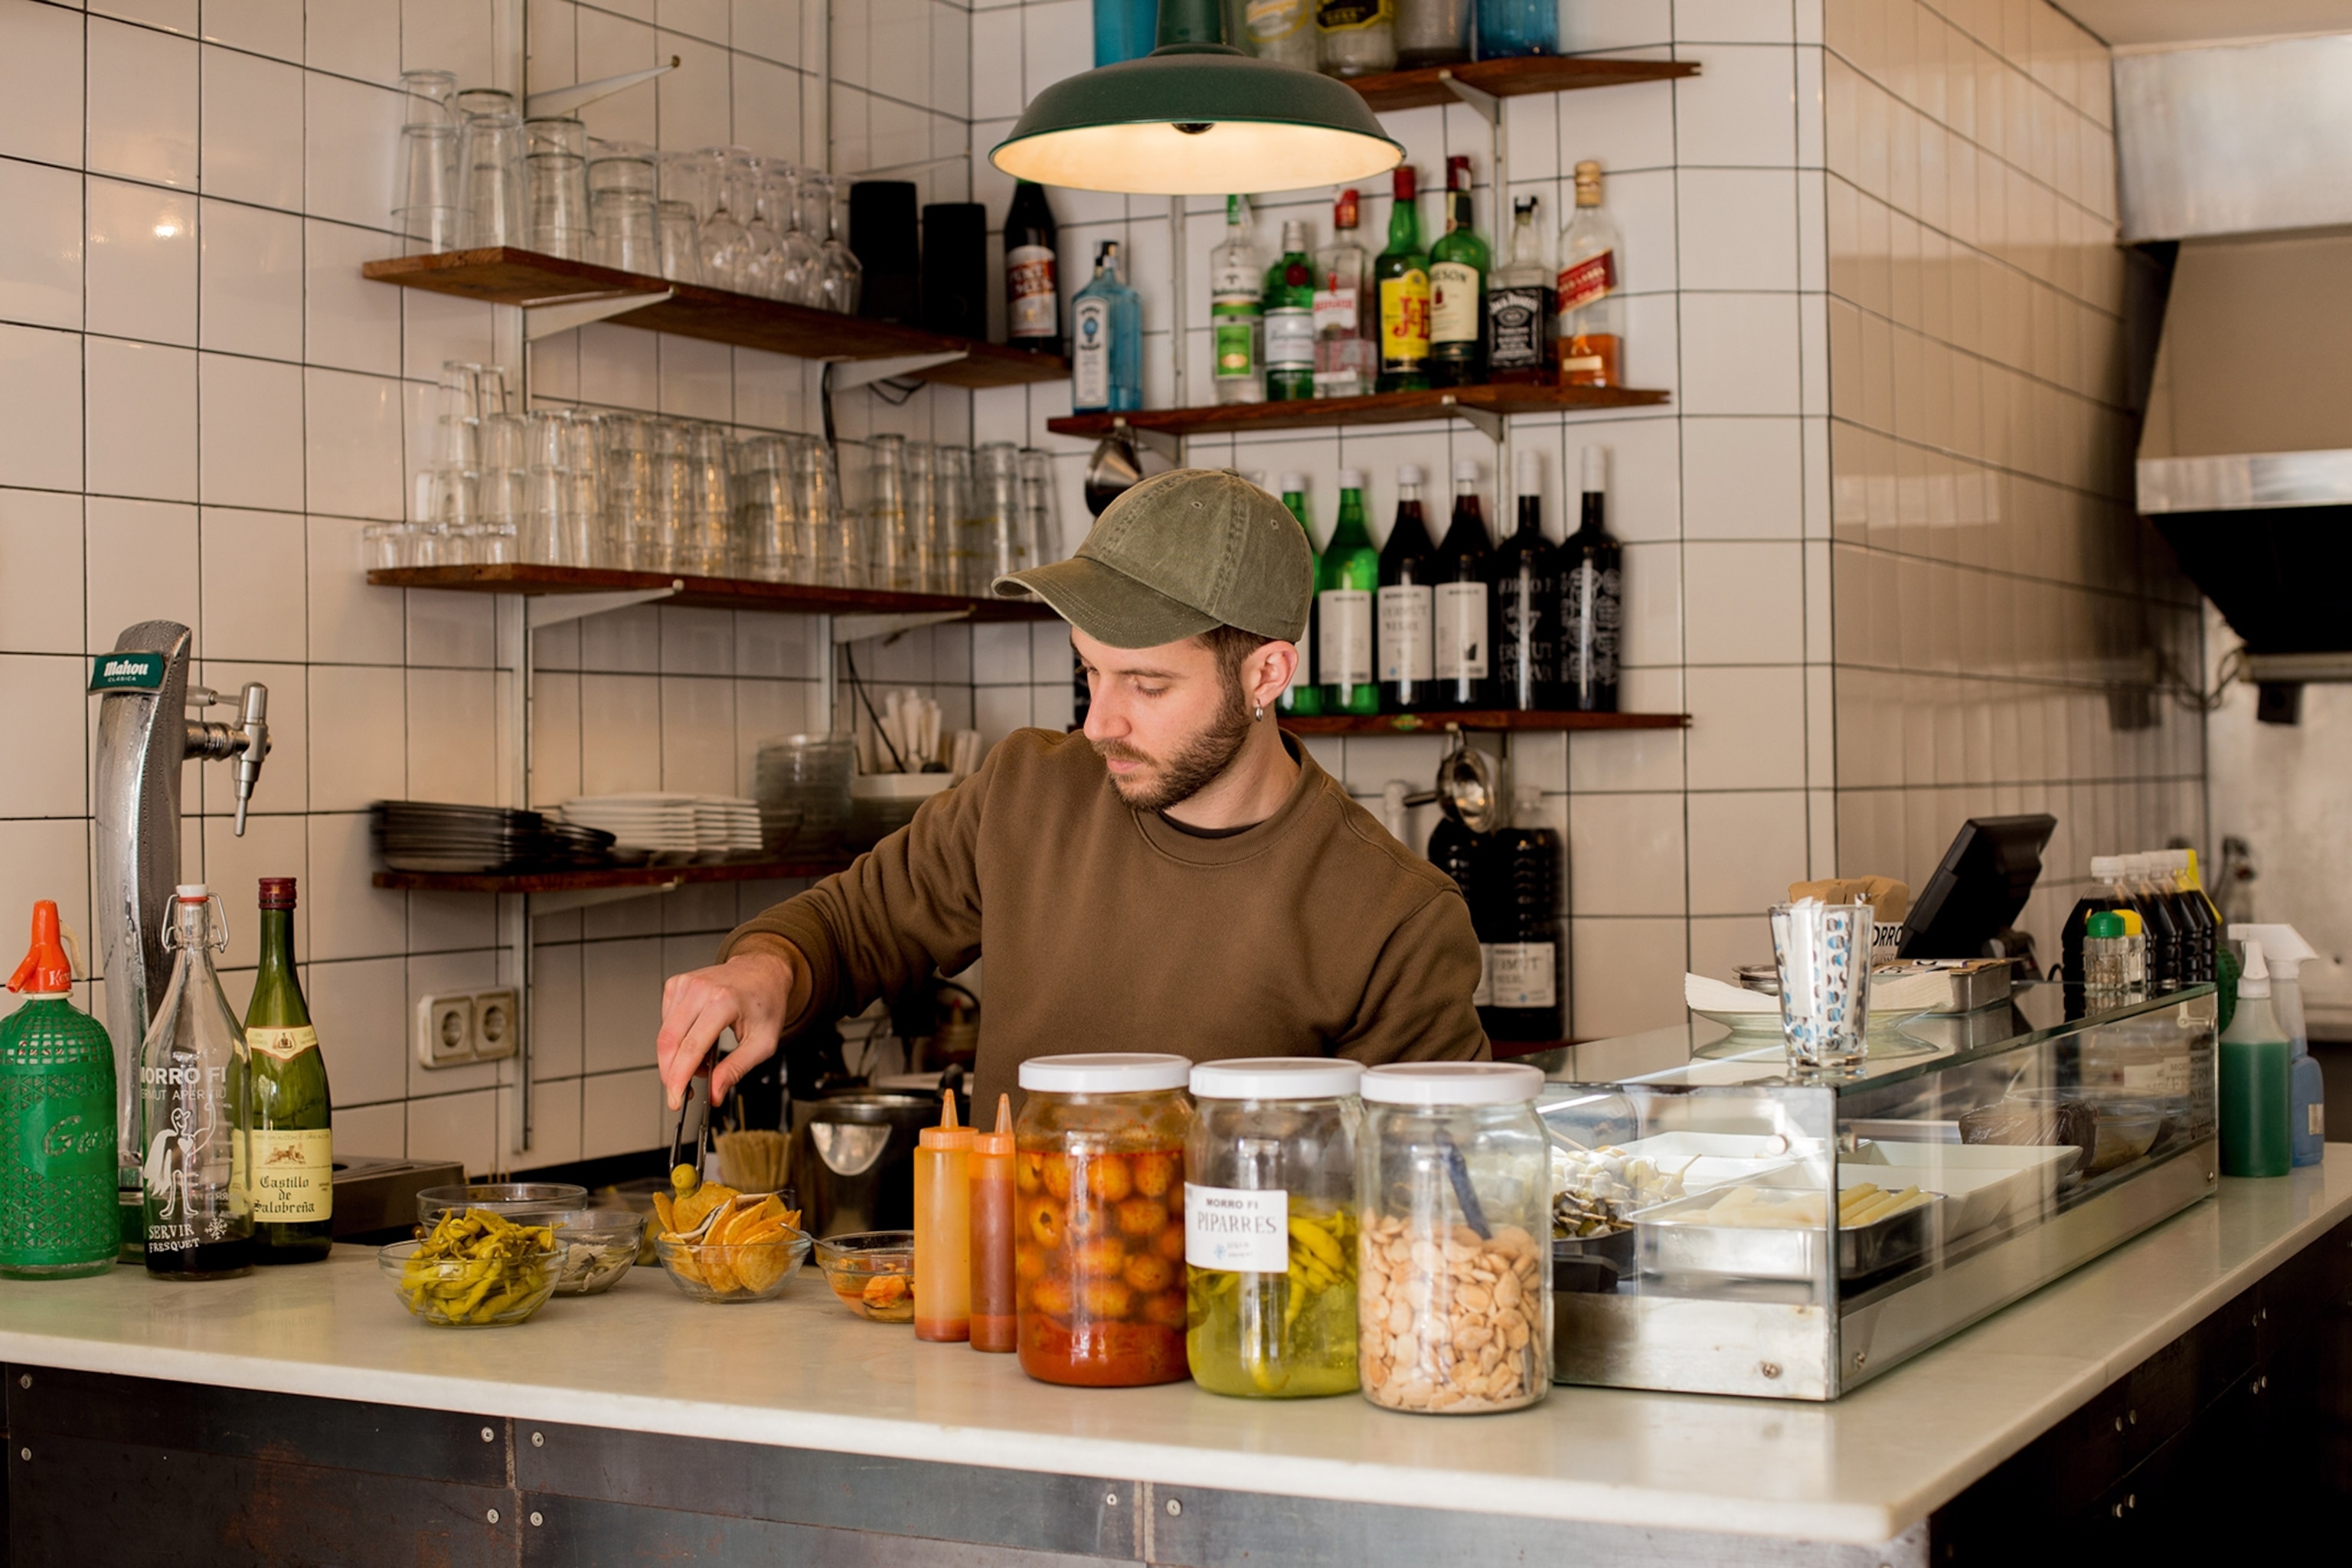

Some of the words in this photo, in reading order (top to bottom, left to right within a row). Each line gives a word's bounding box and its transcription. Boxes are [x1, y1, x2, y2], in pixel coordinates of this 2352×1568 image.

[103, 660, 149, 677] Mahou
[1872, 925, 1903, 947] ORRO
[207, 1067, 227, 1083] FI
[260, 1175, 309, 1189] Castillo
[279, 1188, 292, 1201] de
[253, 1199, 315, 1214] Salobreña
[1206, 1197, 1243, 1210] MORRO
[1197, 1210, 1277, 1234] PIPARRES
[149, 1223, 195, 1240] SERVIR
[149, 1237, 200, 1253] FRESQUET
